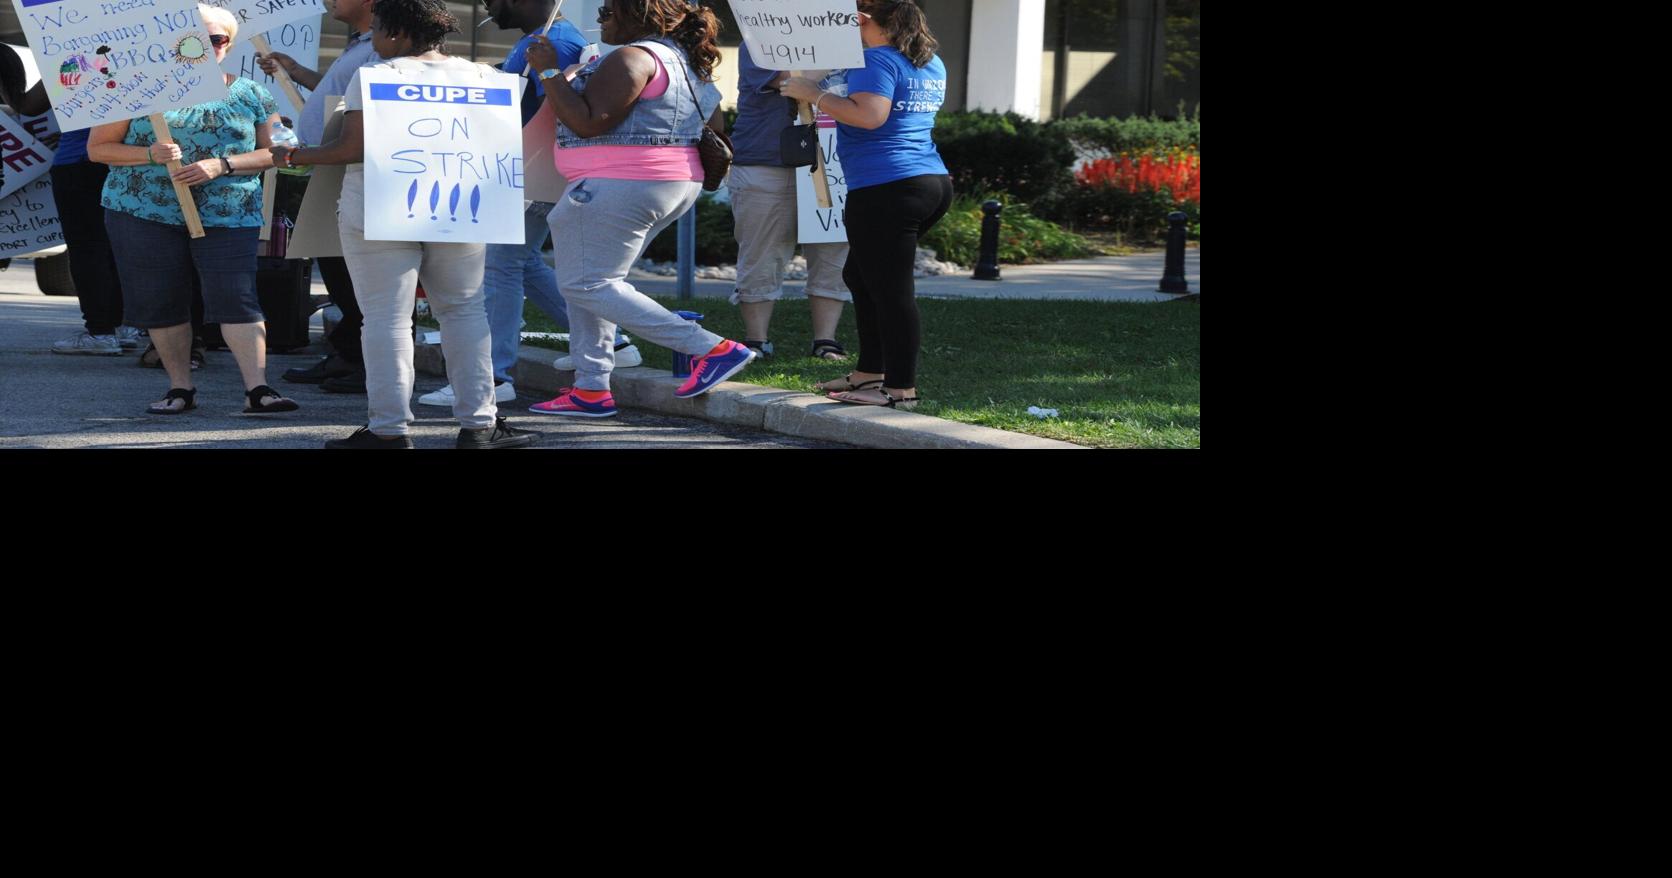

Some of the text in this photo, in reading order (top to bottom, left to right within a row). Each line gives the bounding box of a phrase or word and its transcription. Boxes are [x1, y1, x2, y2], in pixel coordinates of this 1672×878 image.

[30, 6, 88, 30] We
[797, 10, 860, 28] workers
[761, 44, 816, 64] 4914
[55, 77, 105, 119] Burgers
[168, 75, 202, 103] care
[397, 85, 487, 104] CUPE
[408, 117, 469, 140] ON
[391, 149, 525, 189] STRIKE
